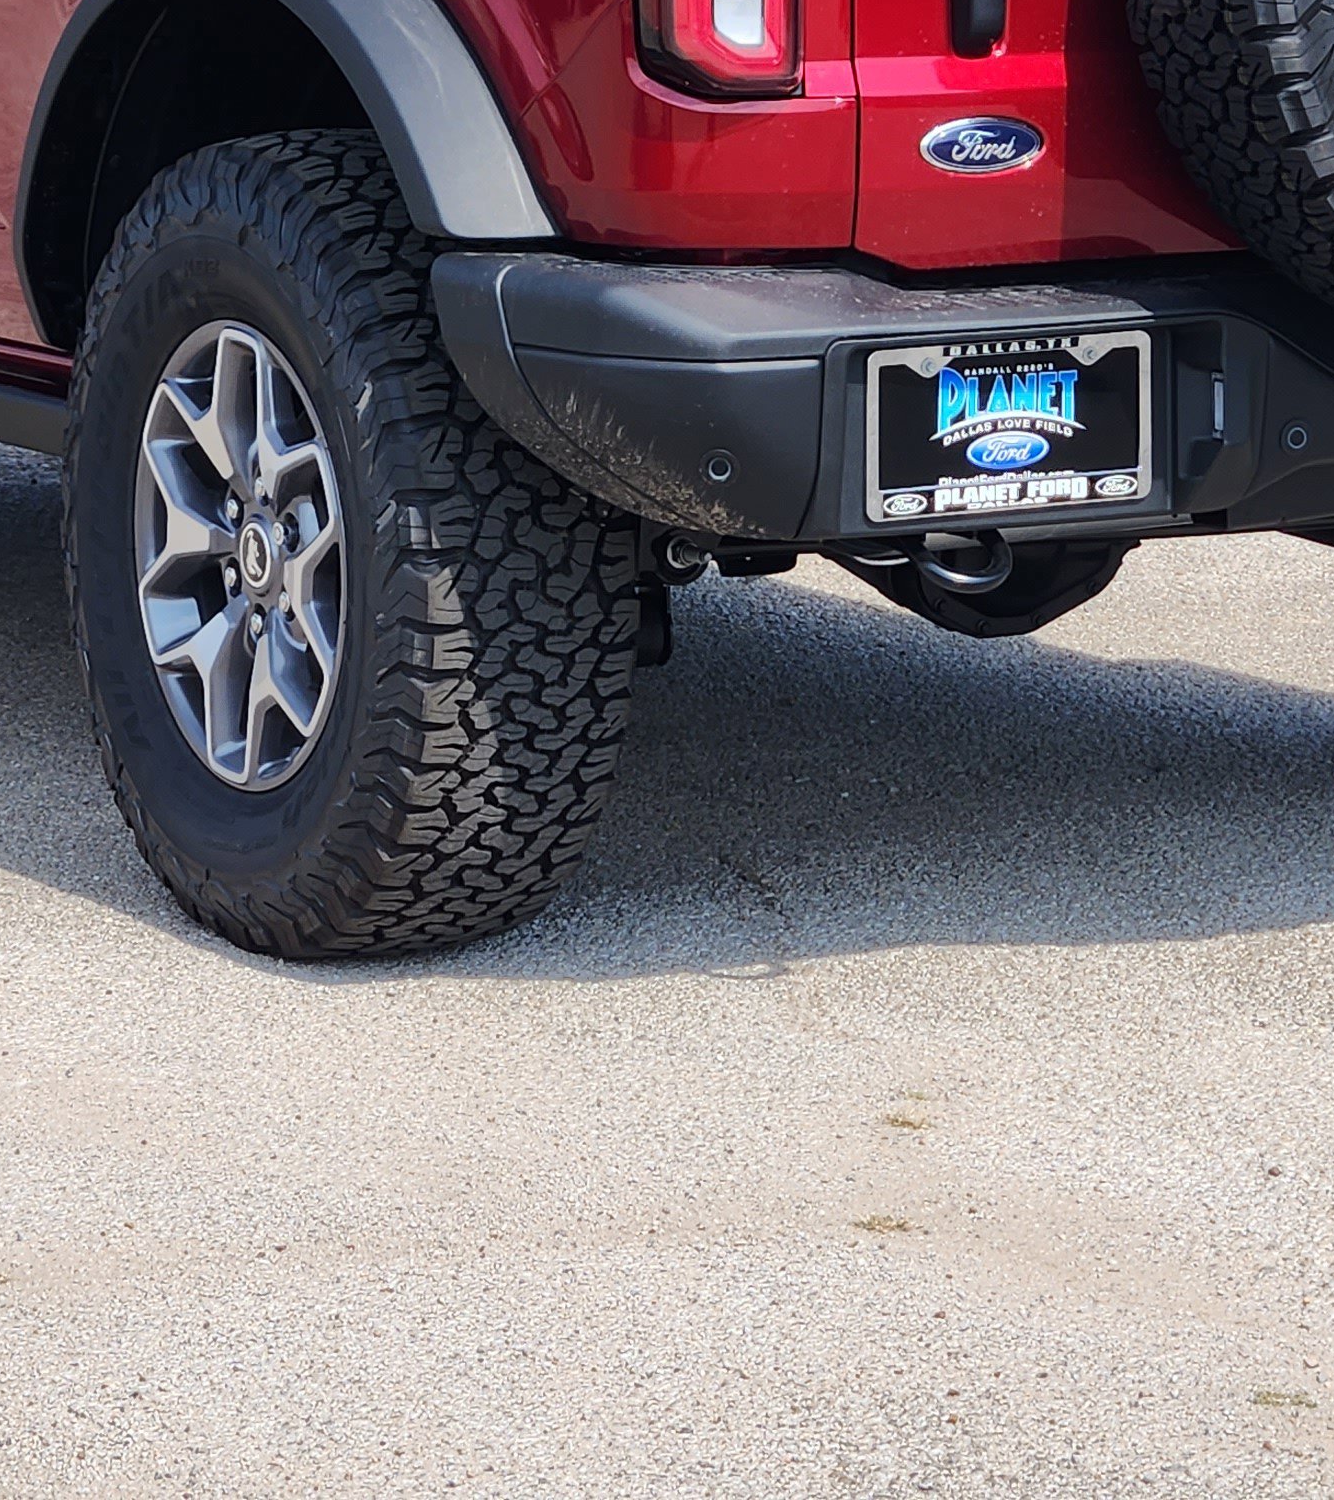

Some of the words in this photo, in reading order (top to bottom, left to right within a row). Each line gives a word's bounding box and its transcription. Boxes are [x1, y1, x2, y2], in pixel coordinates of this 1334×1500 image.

[950, 129, 1017, 162] Ford
[963, 365, 1012, 377] RANDALL
[937, 366, 1079, 435] PLANET
[942, 421, 994, 447] DALLAS
[997, 418, 1032, 430] LOVE
[1034, 419, 1075, 438] FIELD
[934, 482, 1022, 513] PLANET
[1027, 476, 1088, 500] FORD
